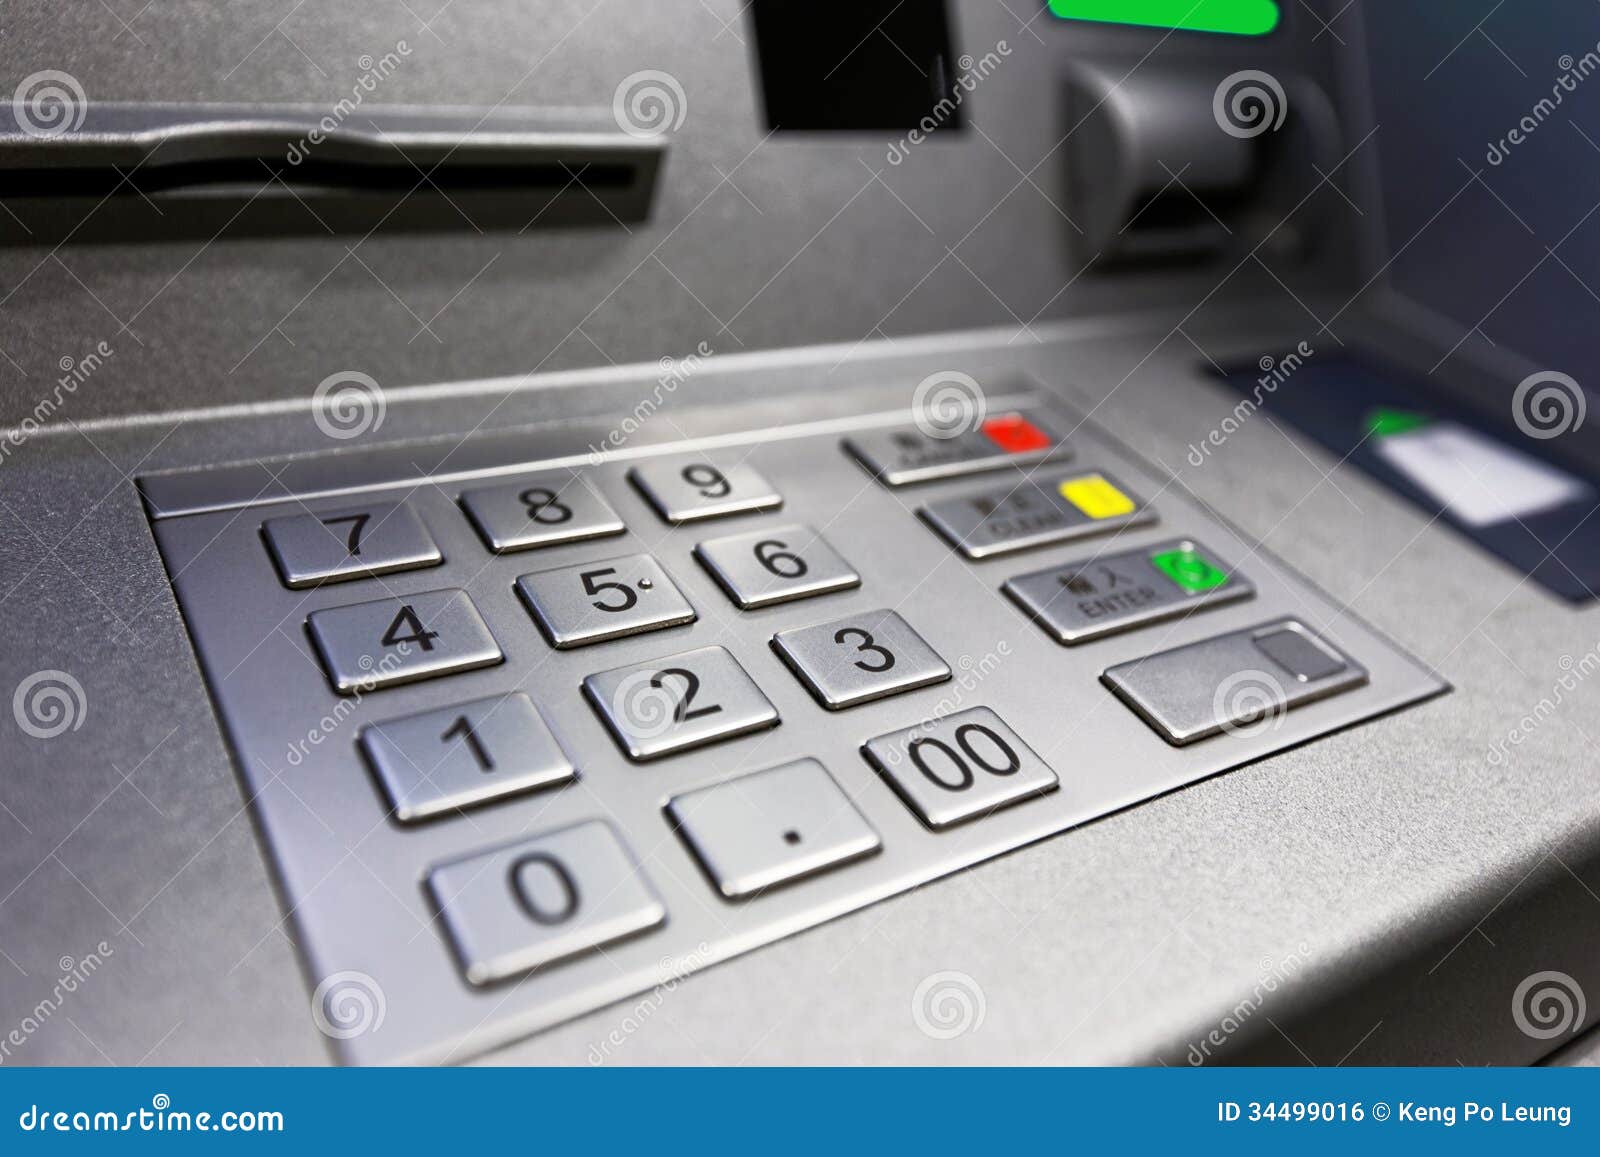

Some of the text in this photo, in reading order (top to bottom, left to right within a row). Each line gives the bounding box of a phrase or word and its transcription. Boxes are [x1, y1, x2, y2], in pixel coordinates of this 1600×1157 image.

[681, 464, 732, 499] 9
[517, 487, 573, 526] 8
[321, 512, 372, 557] 7
[753, 540, 809, 579] 6
[580, 567, 638, 613] 5
[381, 604, 440, 652] 4
[833, 627, 896, 673] 3
[649, 667, 723, 723] 2
[440, 714, 495, 773] 1
[907, 723, 1021, 793] 00
[506, 851, 582, 927] 0
